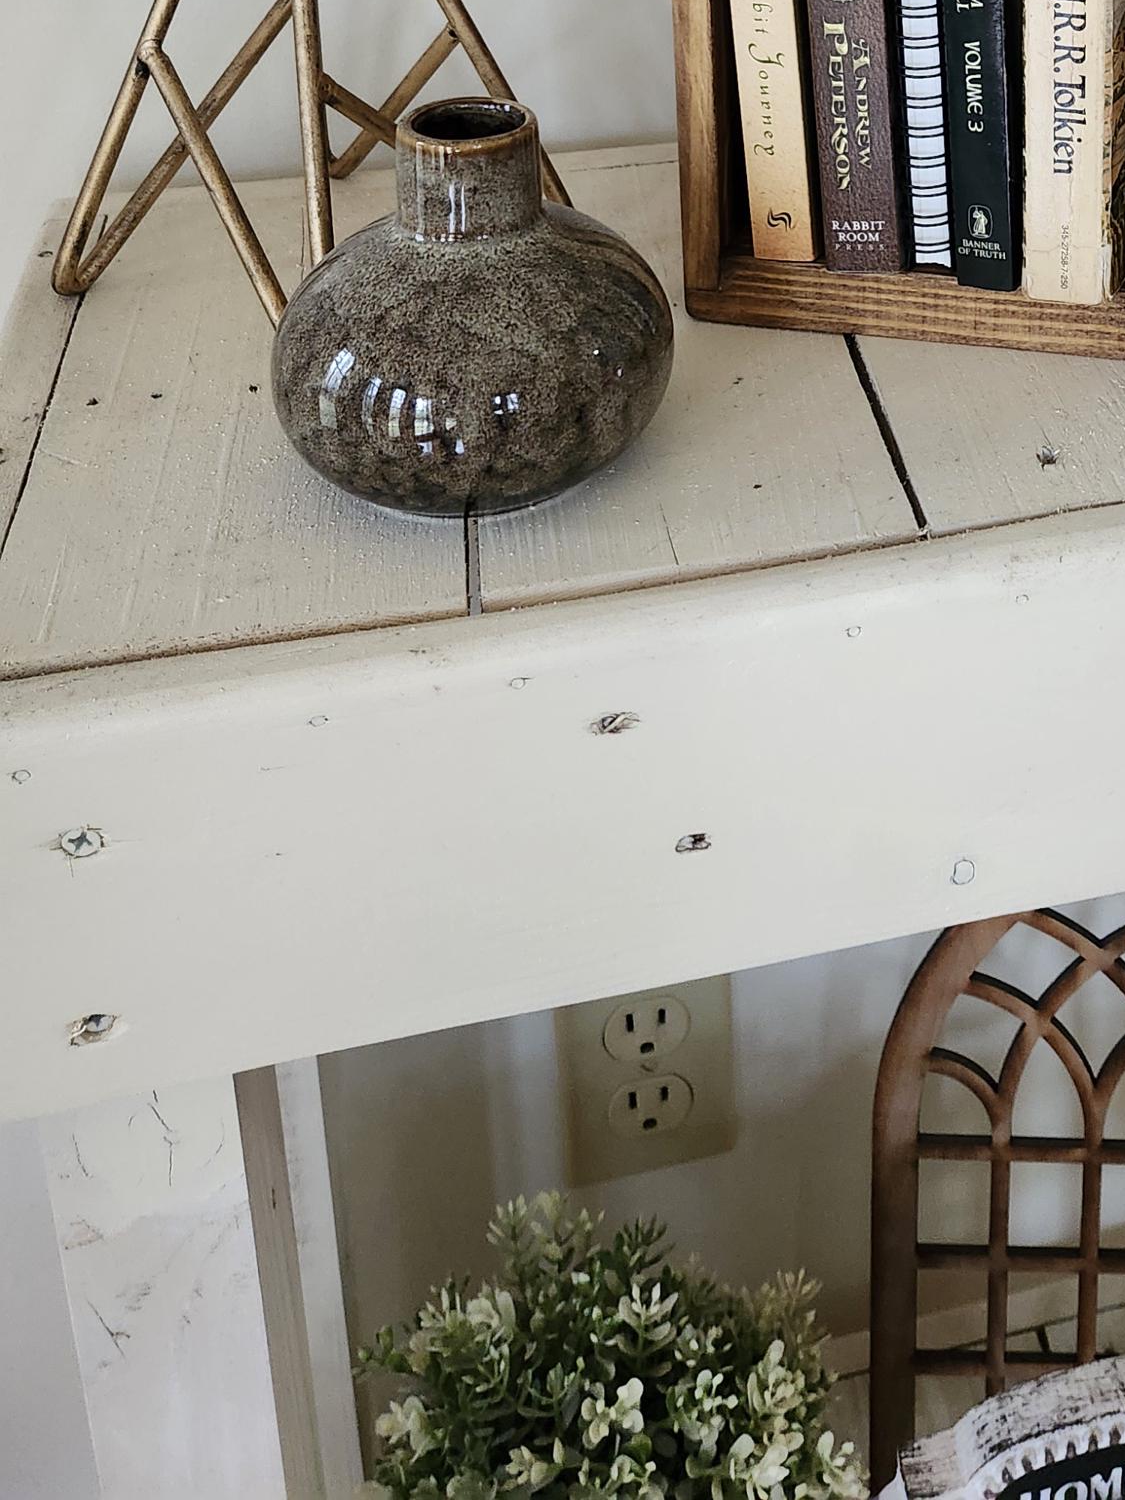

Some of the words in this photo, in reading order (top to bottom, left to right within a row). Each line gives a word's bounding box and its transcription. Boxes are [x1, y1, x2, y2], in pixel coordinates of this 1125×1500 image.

[964, 41, 982, 115] VOLUME
[748, 42, 785, 157] Journey
[822, 16, 852, 191] PETERSON
[851, 38, 871, 169] ANDREW
[968, 120, 984, 133] 3
[831, 220, 886, 231] RABBIT
[838, 232, 880, 242] ROOM
[835, 243, 885, 251] PRESS
[962, 238, 1001, 251] BANNER
[958, 246, 972, 255] OF
[973, 249, 1007, 260] TRUTH
